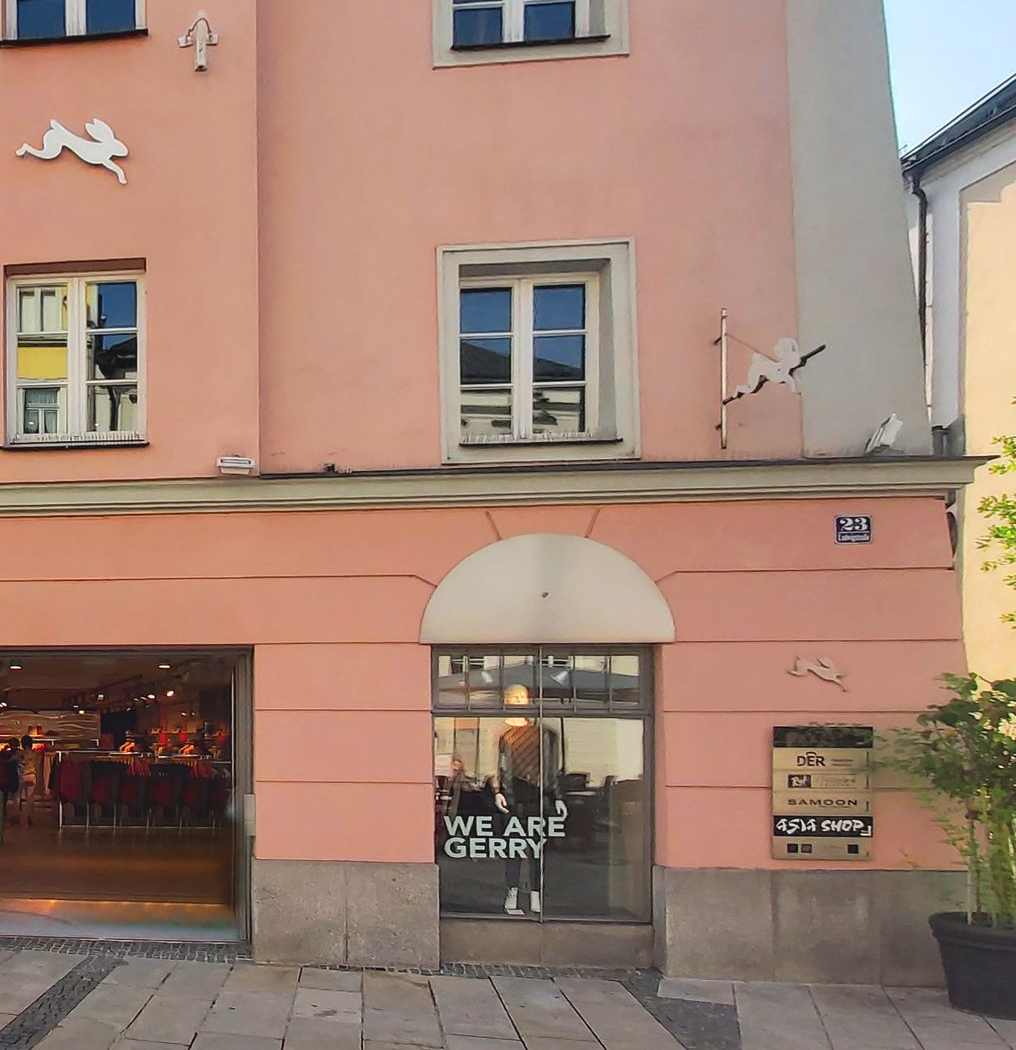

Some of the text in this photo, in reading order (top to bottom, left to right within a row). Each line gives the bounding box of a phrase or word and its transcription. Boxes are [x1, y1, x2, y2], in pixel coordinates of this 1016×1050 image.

[840, 517, 868, 531] 23
[797, 755, 826, 766] DER
[444, 816, 566, 837] WE ARE
[776, 818, 864, 834] ASIA SHOP
[444, 838, 547, 859] GERRY
